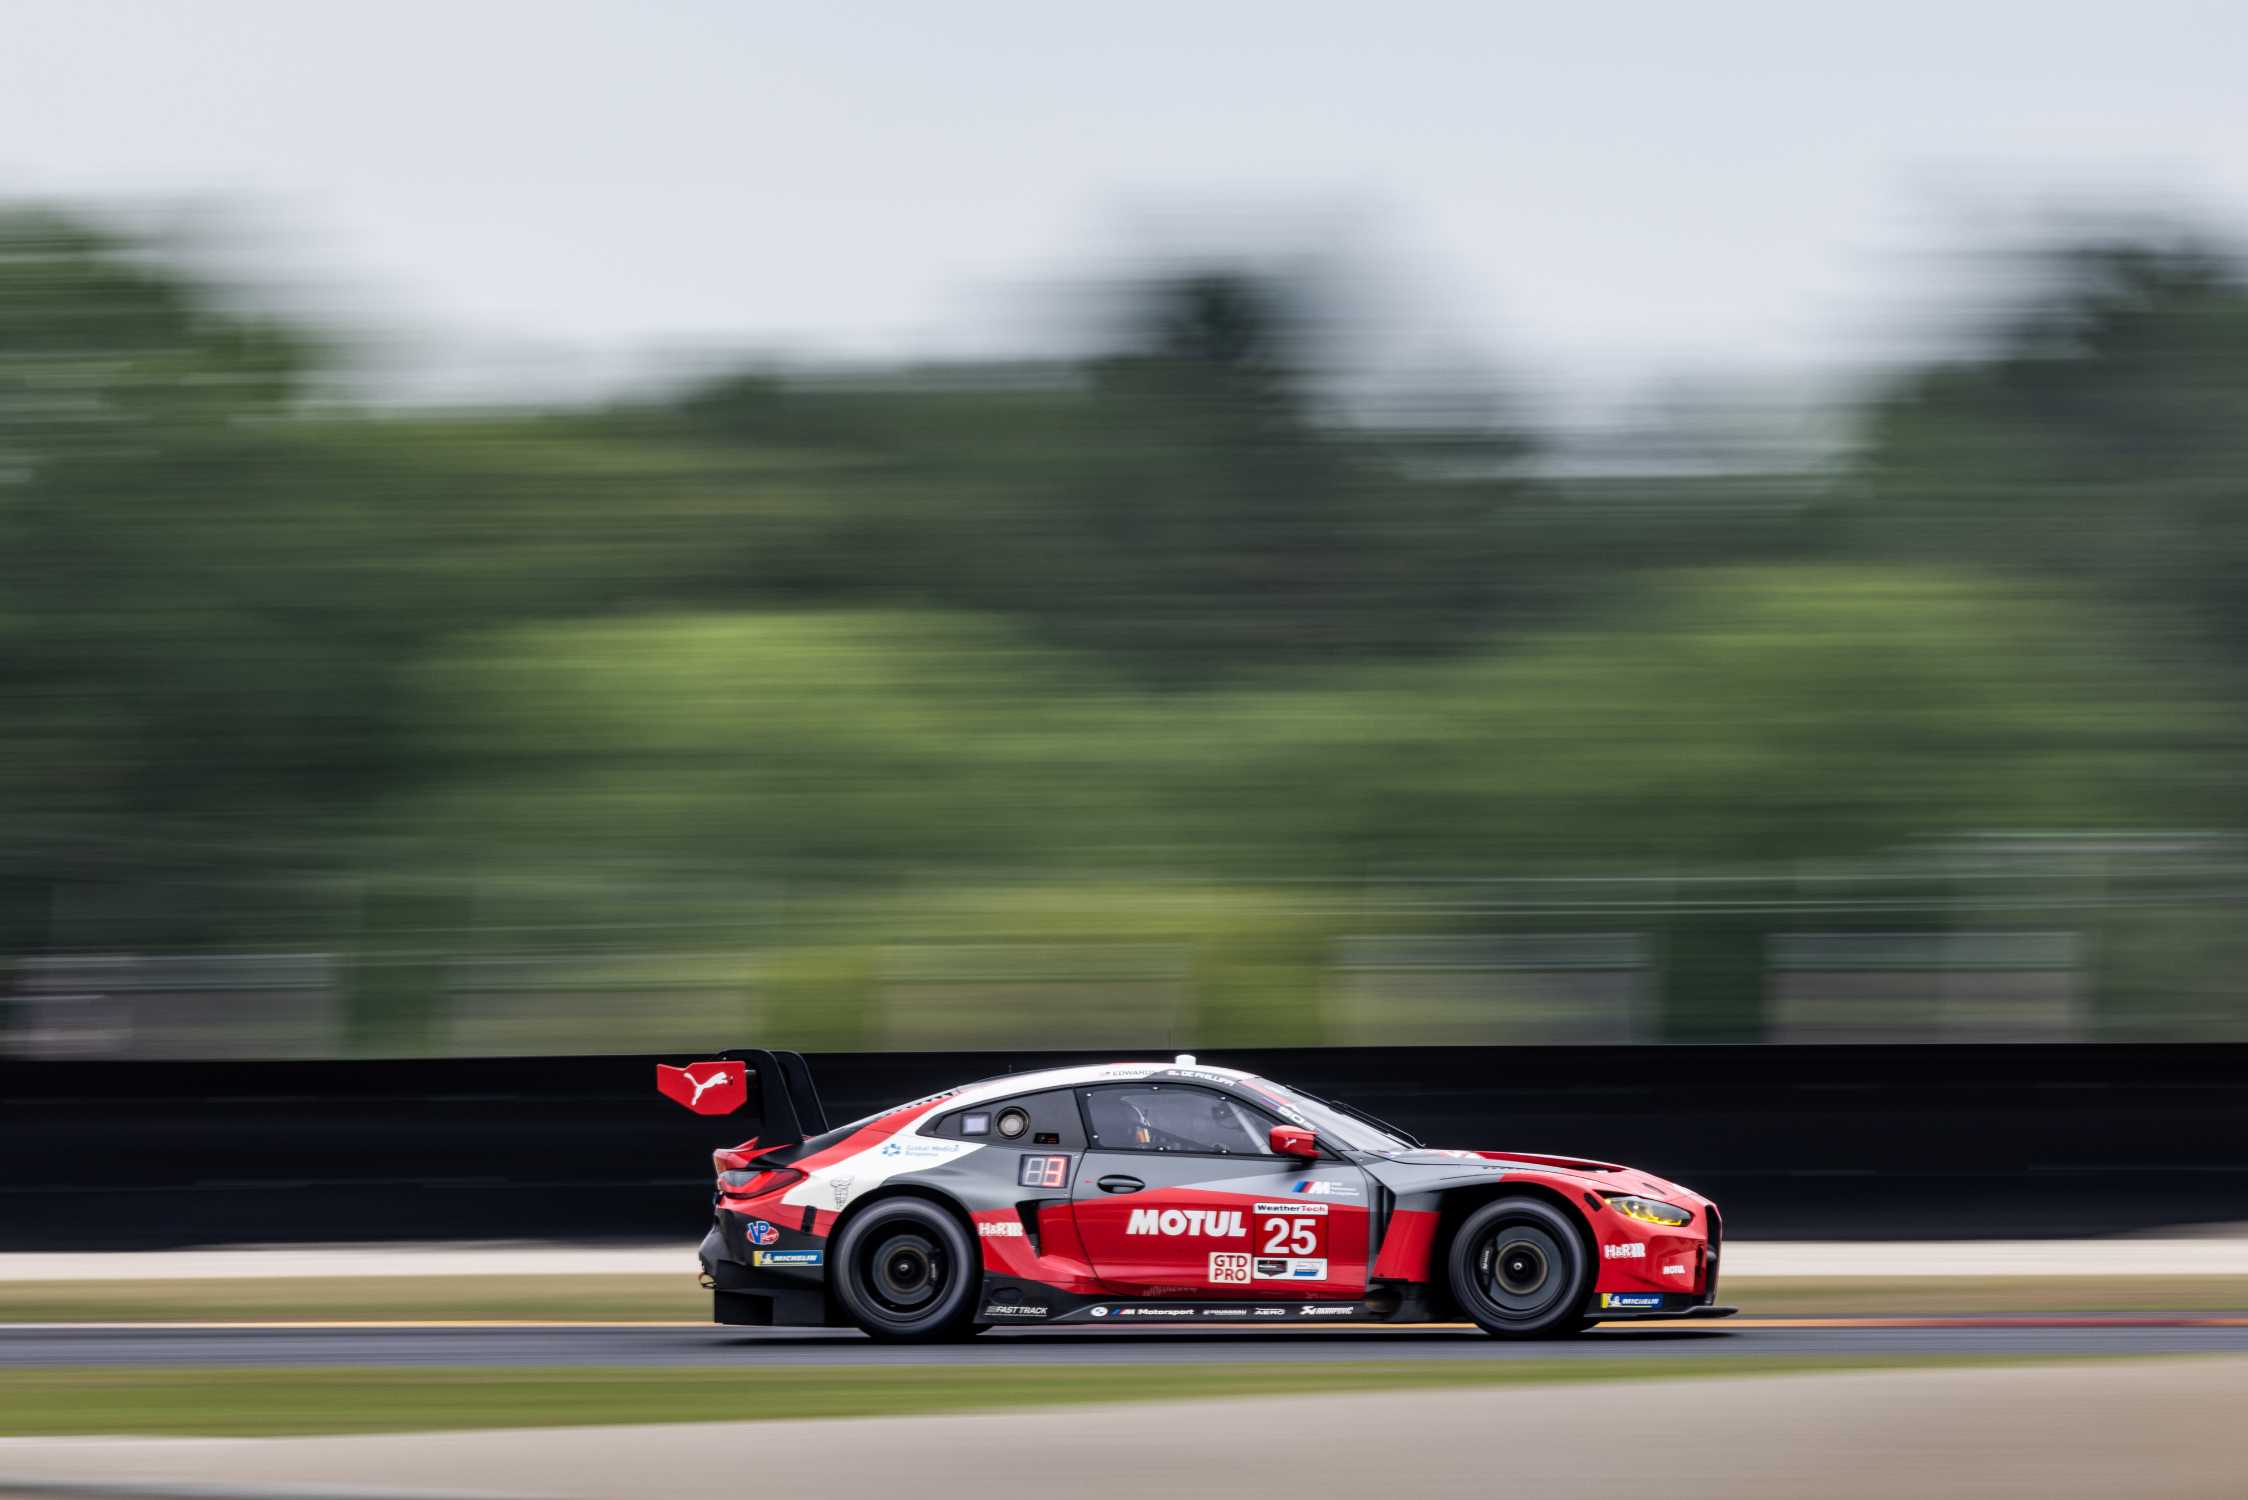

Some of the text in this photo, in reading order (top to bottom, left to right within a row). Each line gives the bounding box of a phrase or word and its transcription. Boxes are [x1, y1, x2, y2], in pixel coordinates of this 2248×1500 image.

[1125, 1208, 1247, 1237] MOTUL
[1263, 1217, 1318, 1256] 25
[1214, 1254, 1248, 1267] GTD
[1214, 1269, 1247, 1281] PRO
[1019, 1306, 1048, 1314] TRACK
